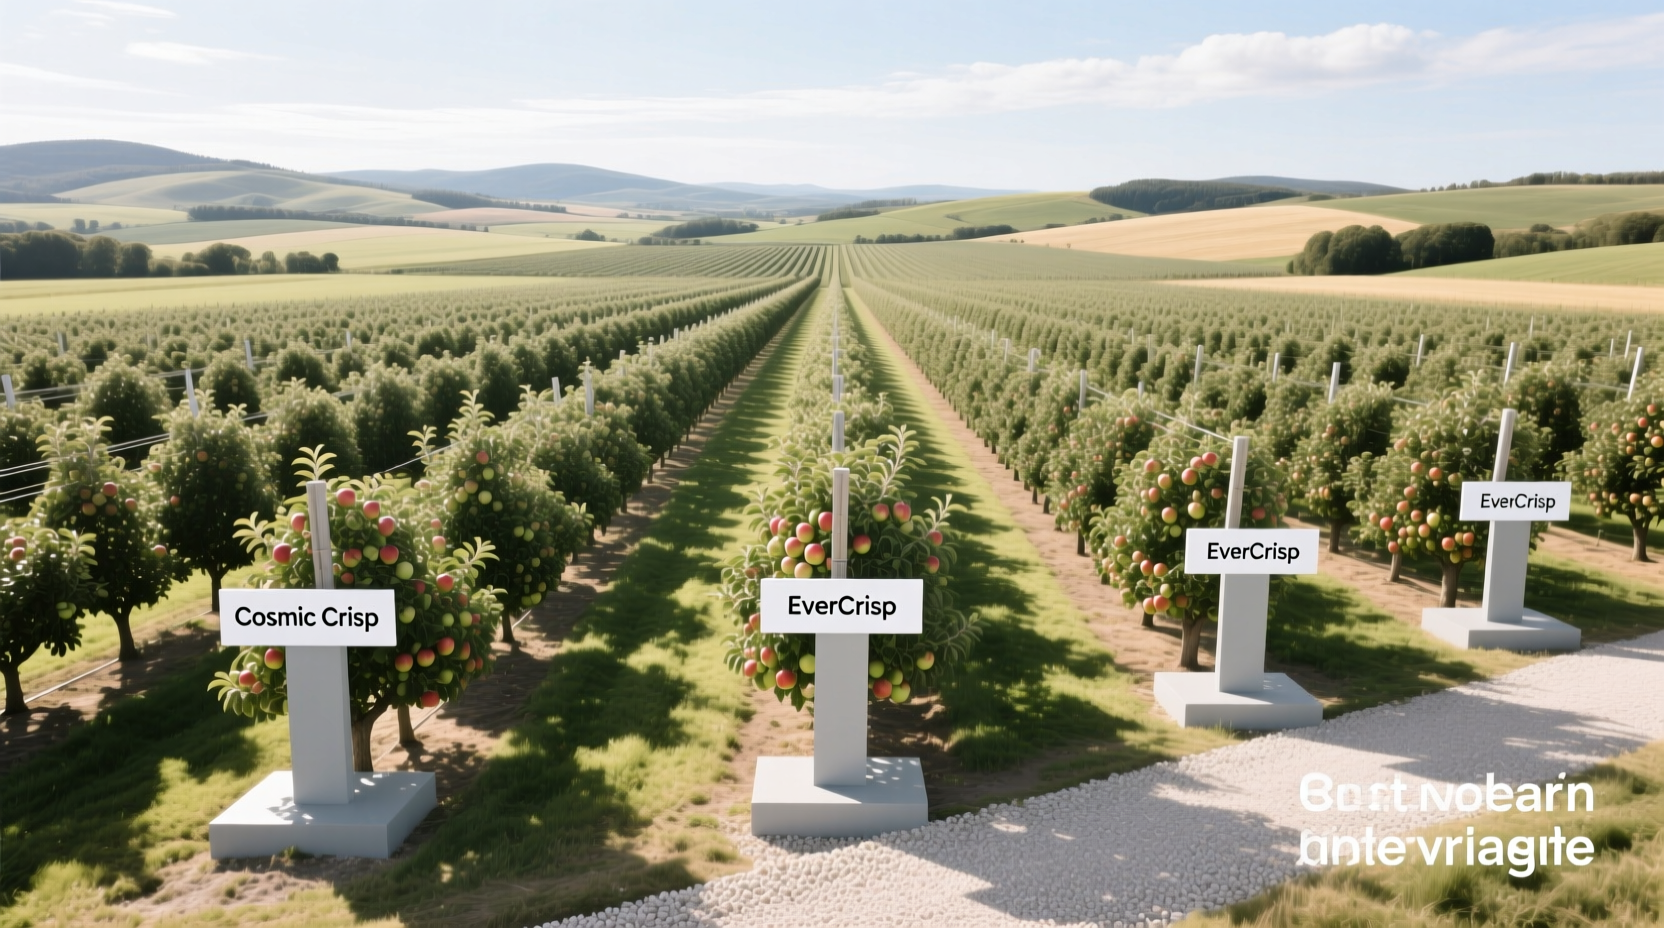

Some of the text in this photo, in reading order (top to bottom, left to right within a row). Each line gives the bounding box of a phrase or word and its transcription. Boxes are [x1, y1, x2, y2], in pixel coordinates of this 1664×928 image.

[1480, 493, 1556, 513] EverCrisp
[1207, 541, 1300, 564] EverCrisp
[235, 606, 379, 632] Cosmic Crisp
[788, 595, 897, 620] EverCrisp
